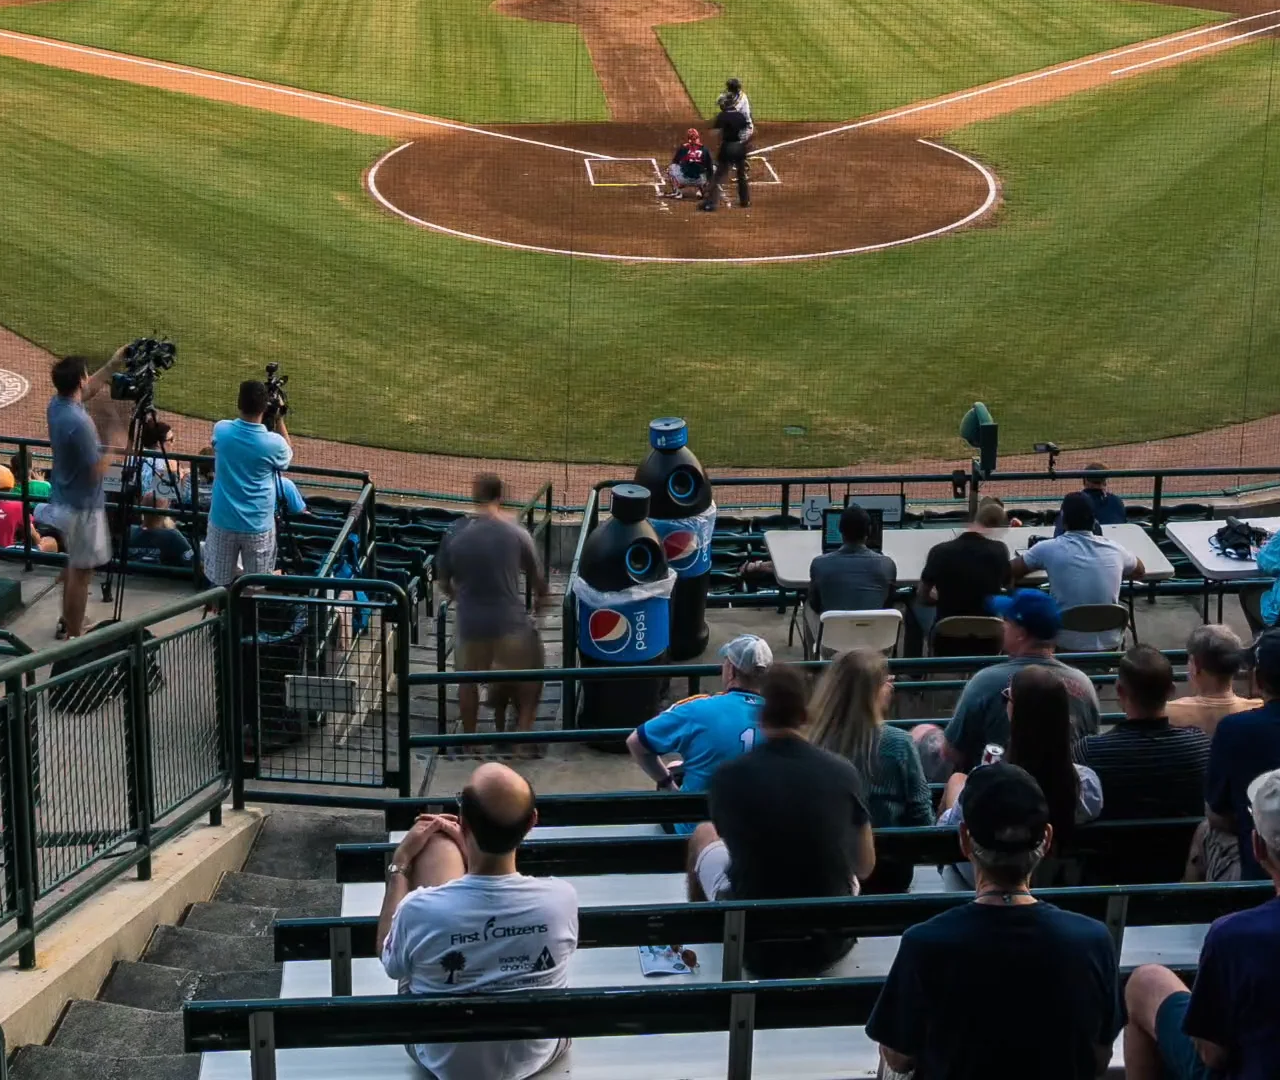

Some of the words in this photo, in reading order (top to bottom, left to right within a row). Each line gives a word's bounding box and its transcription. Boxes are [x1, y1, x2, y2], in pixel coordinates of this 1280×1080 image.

[635, 610, 648, 651] pepsi
[450, 931, 481, 946] First
[491, 923, 548, 938] Citizens
